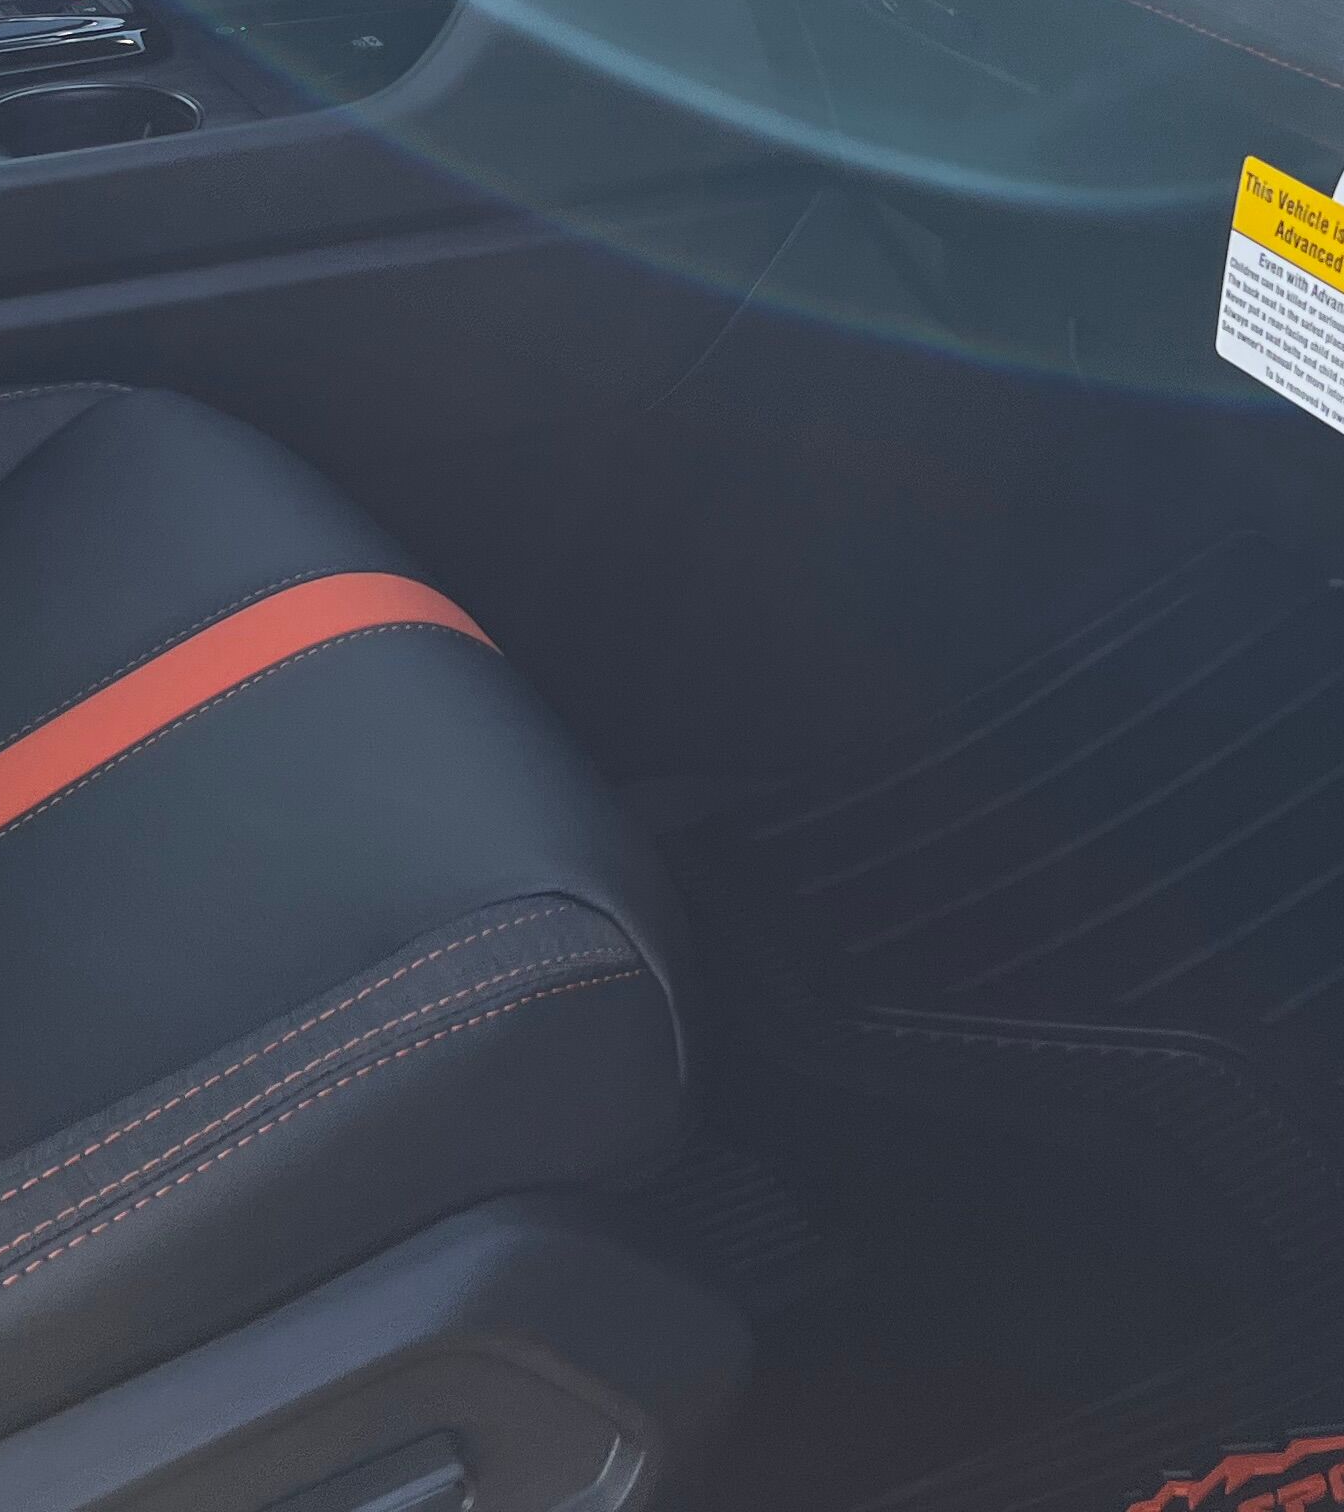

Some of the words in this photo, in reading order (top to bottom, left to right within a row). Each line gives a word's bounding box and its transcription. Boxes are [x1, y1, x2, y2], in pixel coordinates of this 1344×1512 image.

[1246, 171, 1274, 203] This
[1278, 189, 1330, 235] Vehicle
[1258, 252, 1284, 279] Even
[1286, 271, 1309, 294] with
[1274, 219, 1344, 273] Advanced
